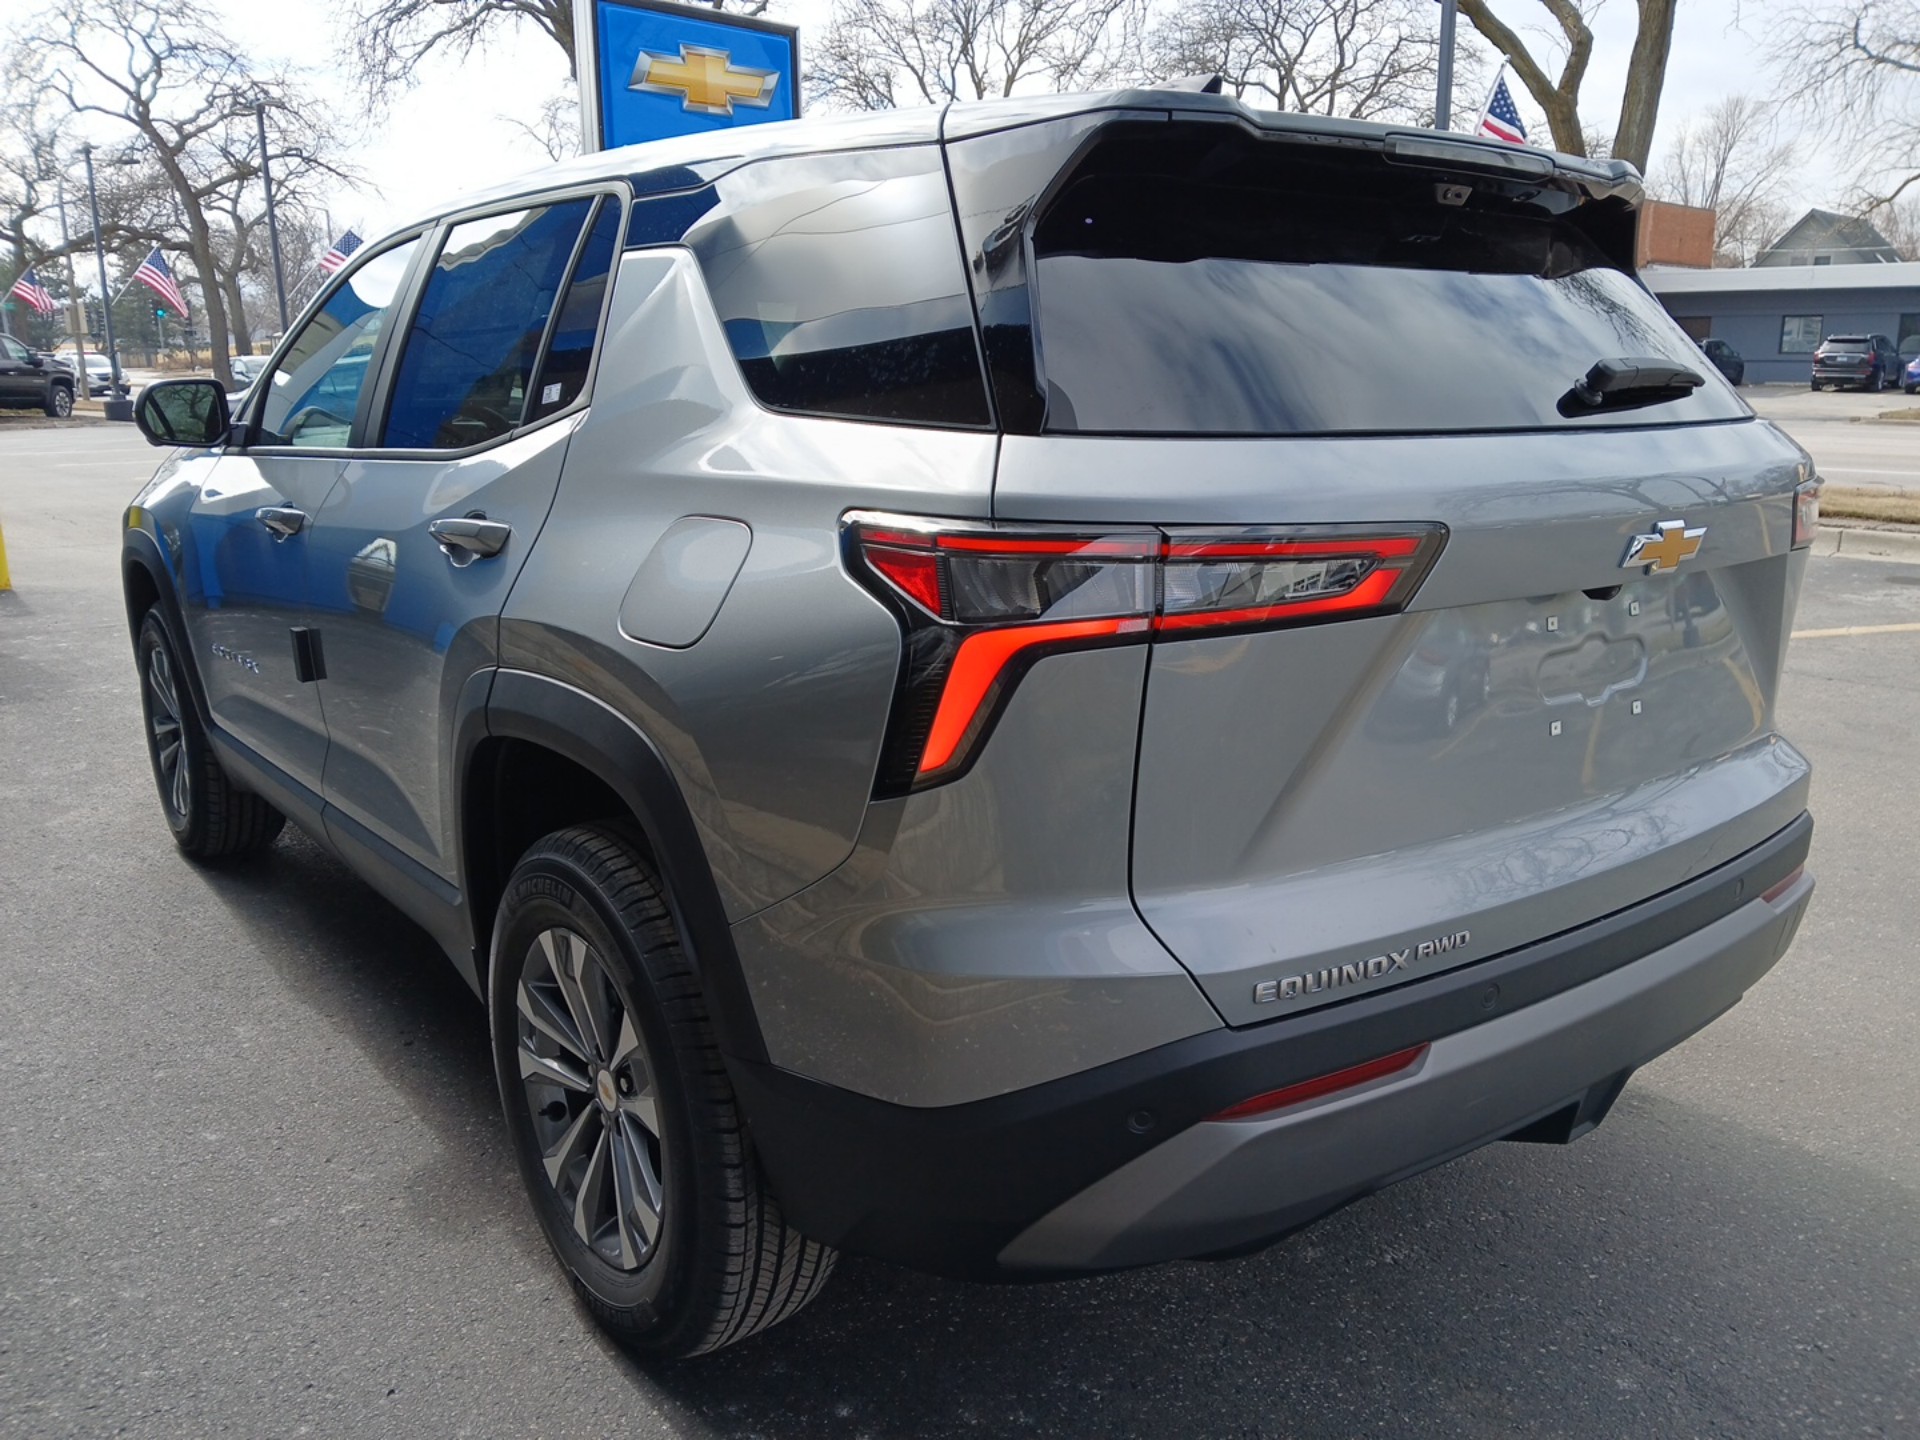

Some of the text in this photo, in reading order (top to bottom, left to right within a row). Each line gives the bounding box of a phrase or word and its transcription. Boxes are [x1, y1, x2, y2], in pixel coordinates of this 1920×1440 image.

[519, 878, 572, 907] MICHELIN
[1254, 930, 1470, 1003] EQUINOX AWD
